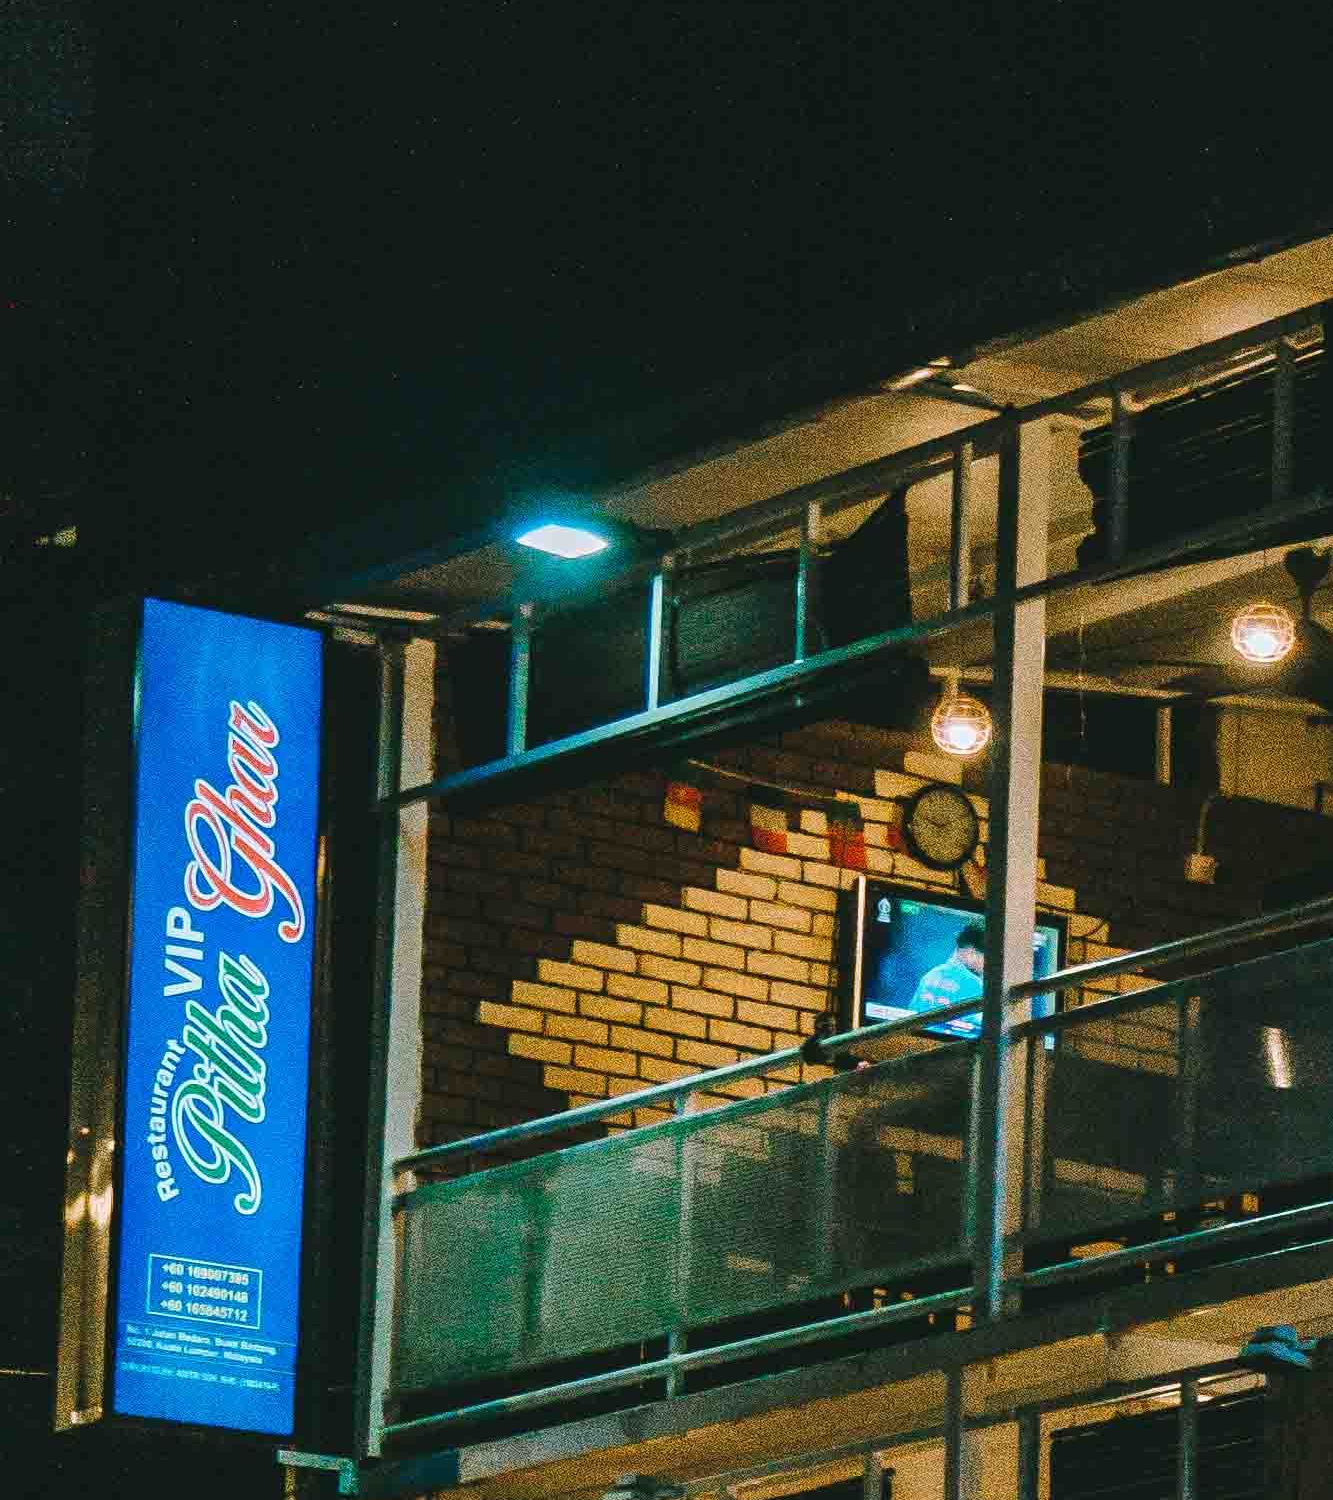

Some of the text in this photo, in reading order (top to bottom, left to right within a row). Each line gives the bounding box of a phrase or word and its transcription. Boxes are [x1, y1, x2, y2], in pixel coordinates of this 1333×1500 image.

[185, 699, 305, 944] Ghar
[163, 906, 205, 998] VIP
[145, 1039, 186, 1202] Restaurant
[172, 951, 270, 1217] Pitha
